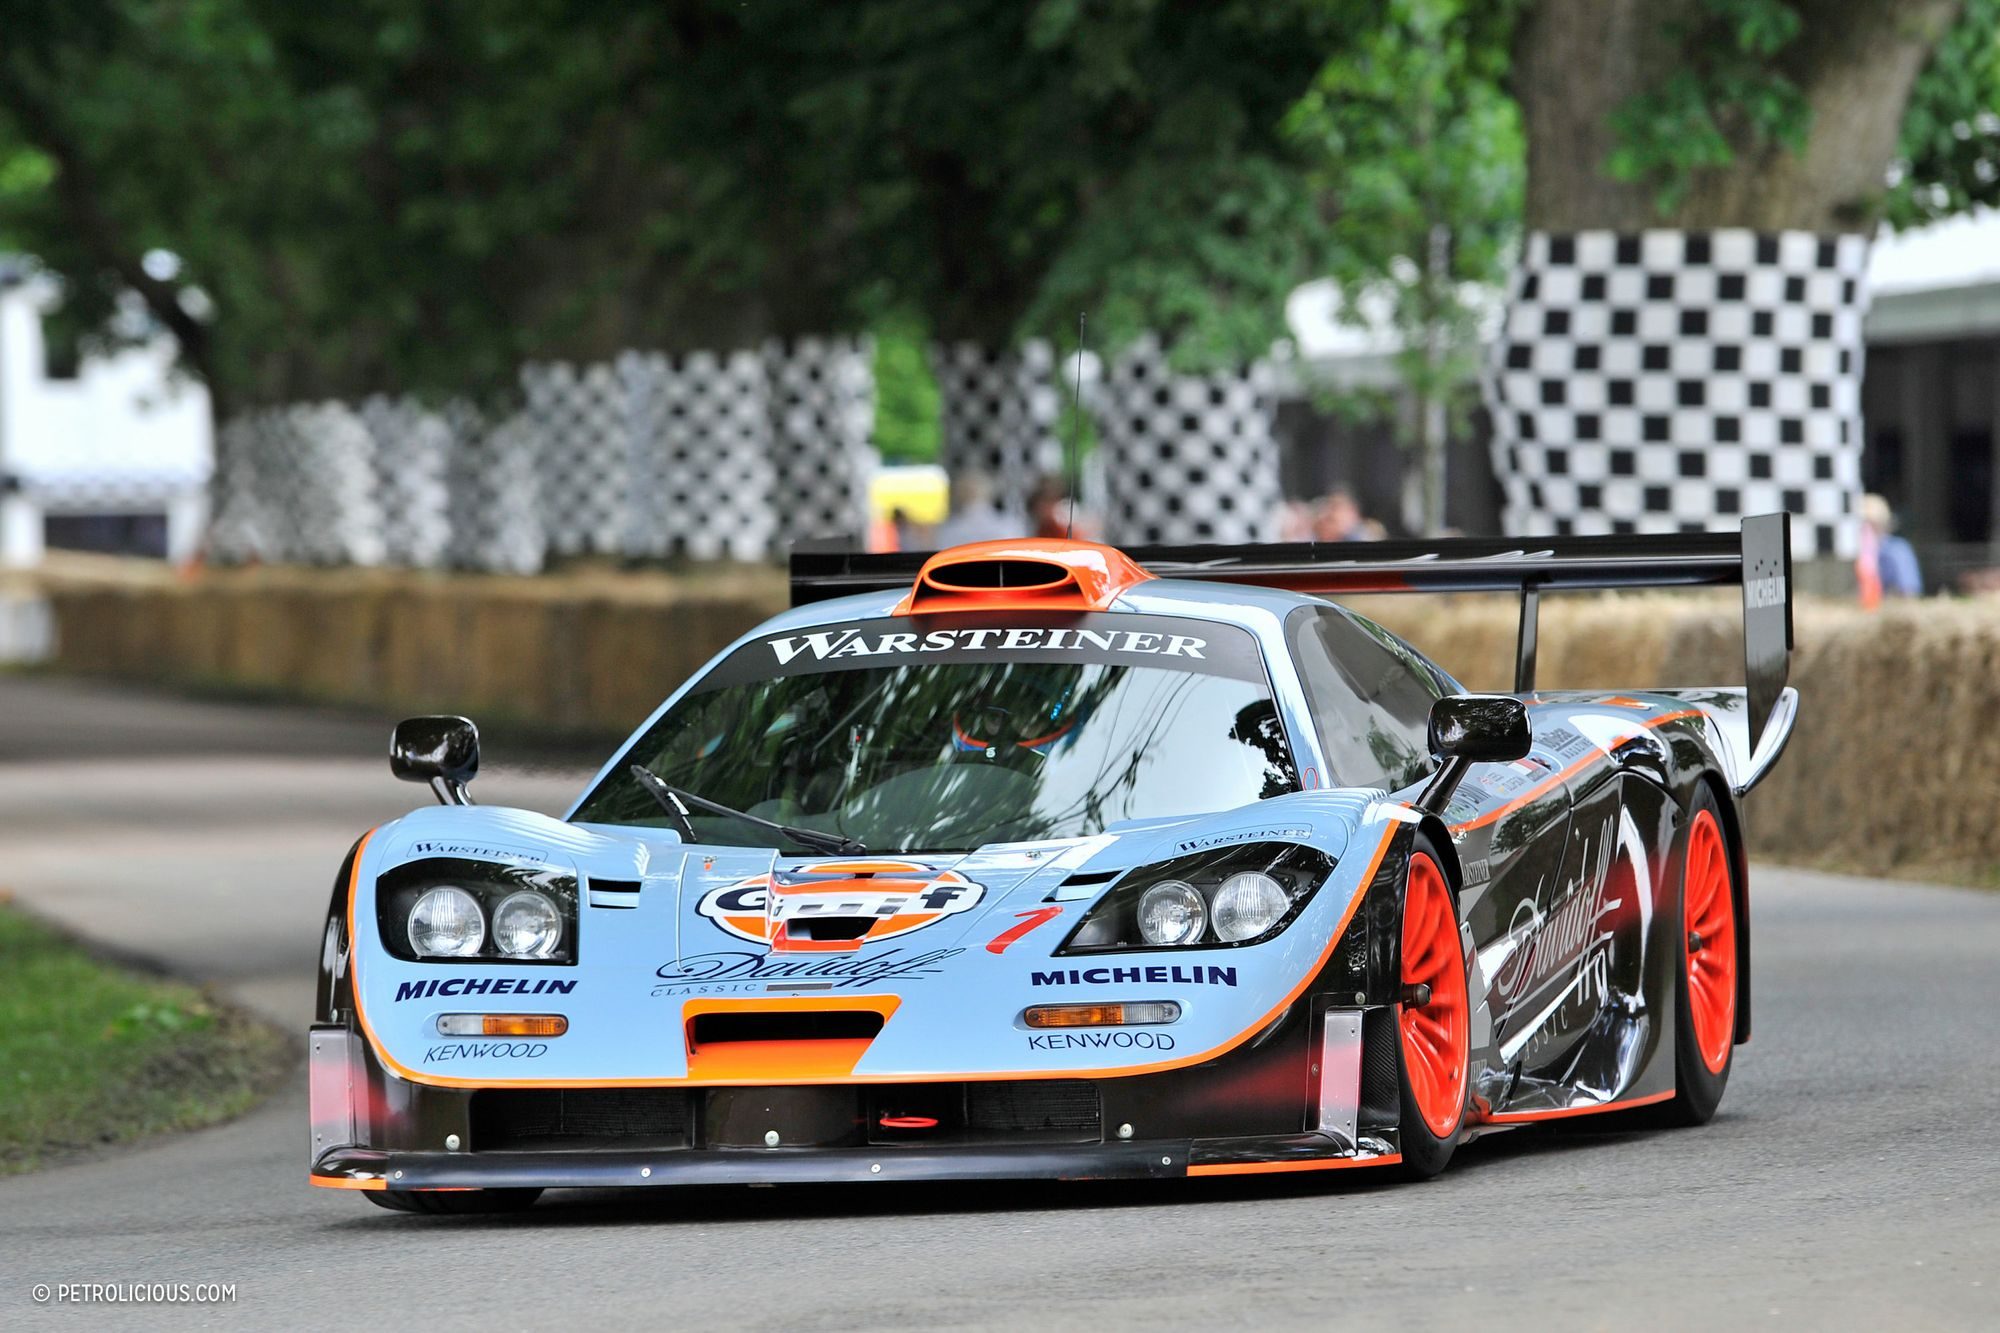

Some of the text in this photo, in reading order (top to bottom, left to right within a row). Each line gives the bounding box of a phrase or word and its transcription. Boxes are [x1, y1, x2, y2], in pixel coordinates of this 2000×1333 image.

[767, 627, 1207, 665] WARSTEINER
[1180, 829, 1308, 851] WARSTEINER
[655, 948, 967, 988] Davidoff
[1031, 966, 1238, 987] MICHELIN
[394, 978, 579, 1003] MICHELIN
[650, 984, 757, 998] CLASSIC
[1028, 1031, 1175, 1051] KENWOOD
[423, 1042, 549, 1065] KENWOOD
